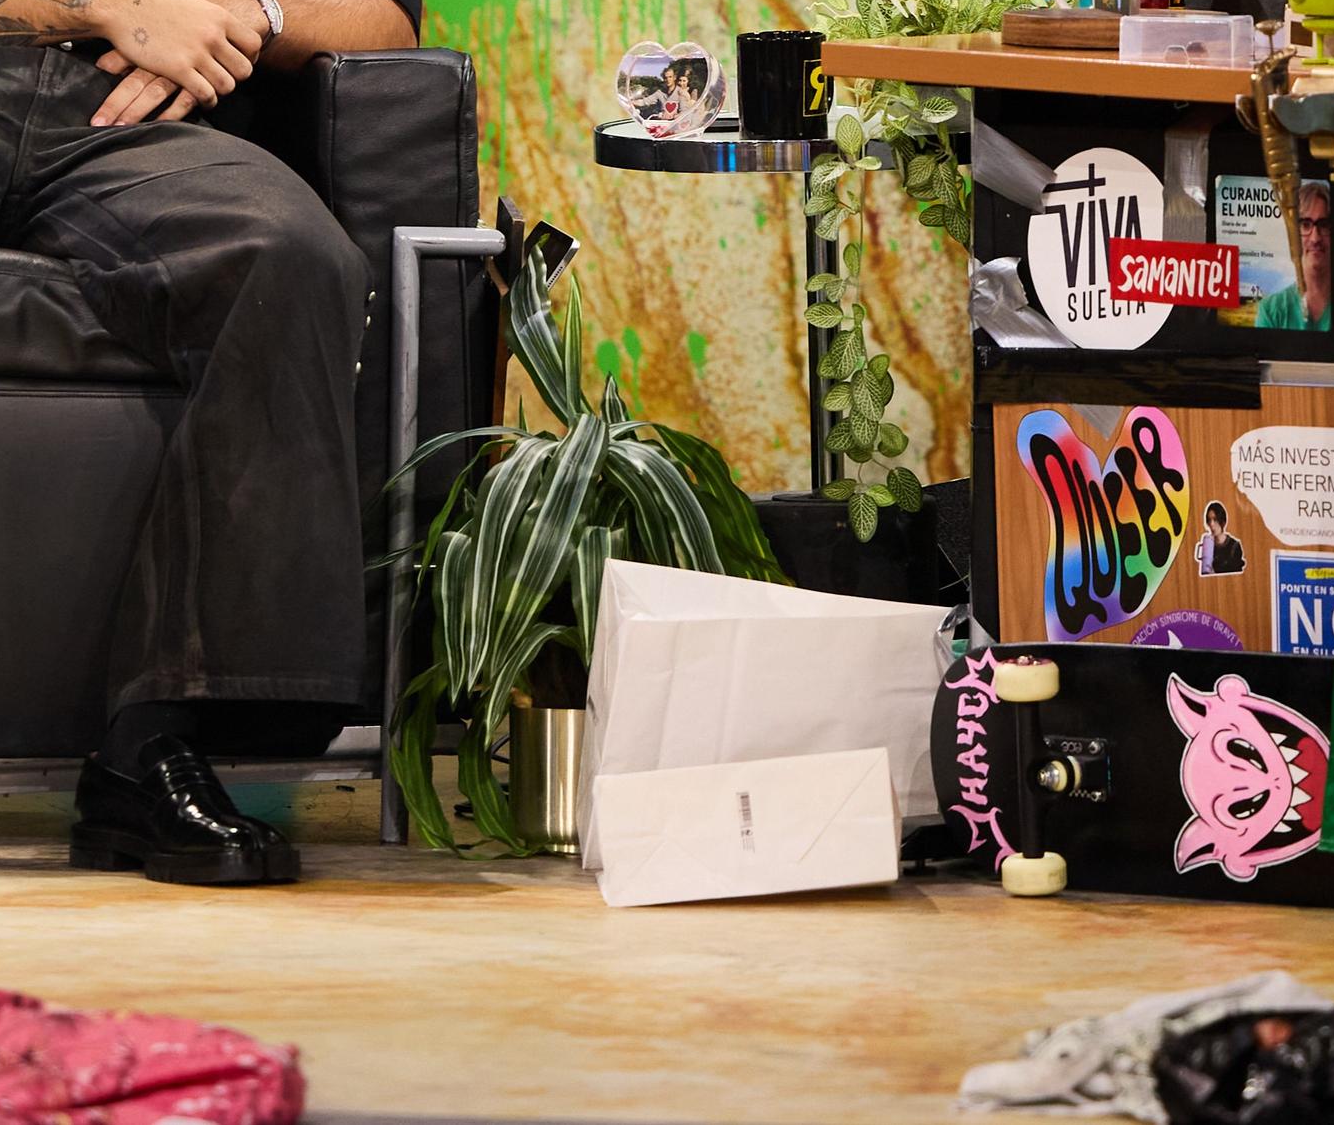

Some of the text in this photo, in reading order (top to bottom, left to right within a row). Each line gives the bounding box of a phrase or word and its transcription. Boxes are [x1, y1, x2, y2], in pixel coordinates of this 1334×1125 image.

[1221, 203, 1282, 219] EL MUNDO
[1238, 439, 1275, 464] MÁS
[1242, 470, 1265, 489] EN
[1029, 416, 1185, 635] QUEER
[1280, 583, 1312, 595] PONTE
[1313, 585, 1327, 595] EN
[1201, 615, 1211, 627] DE
[1212, 619, 1241, 647] DRAVET
